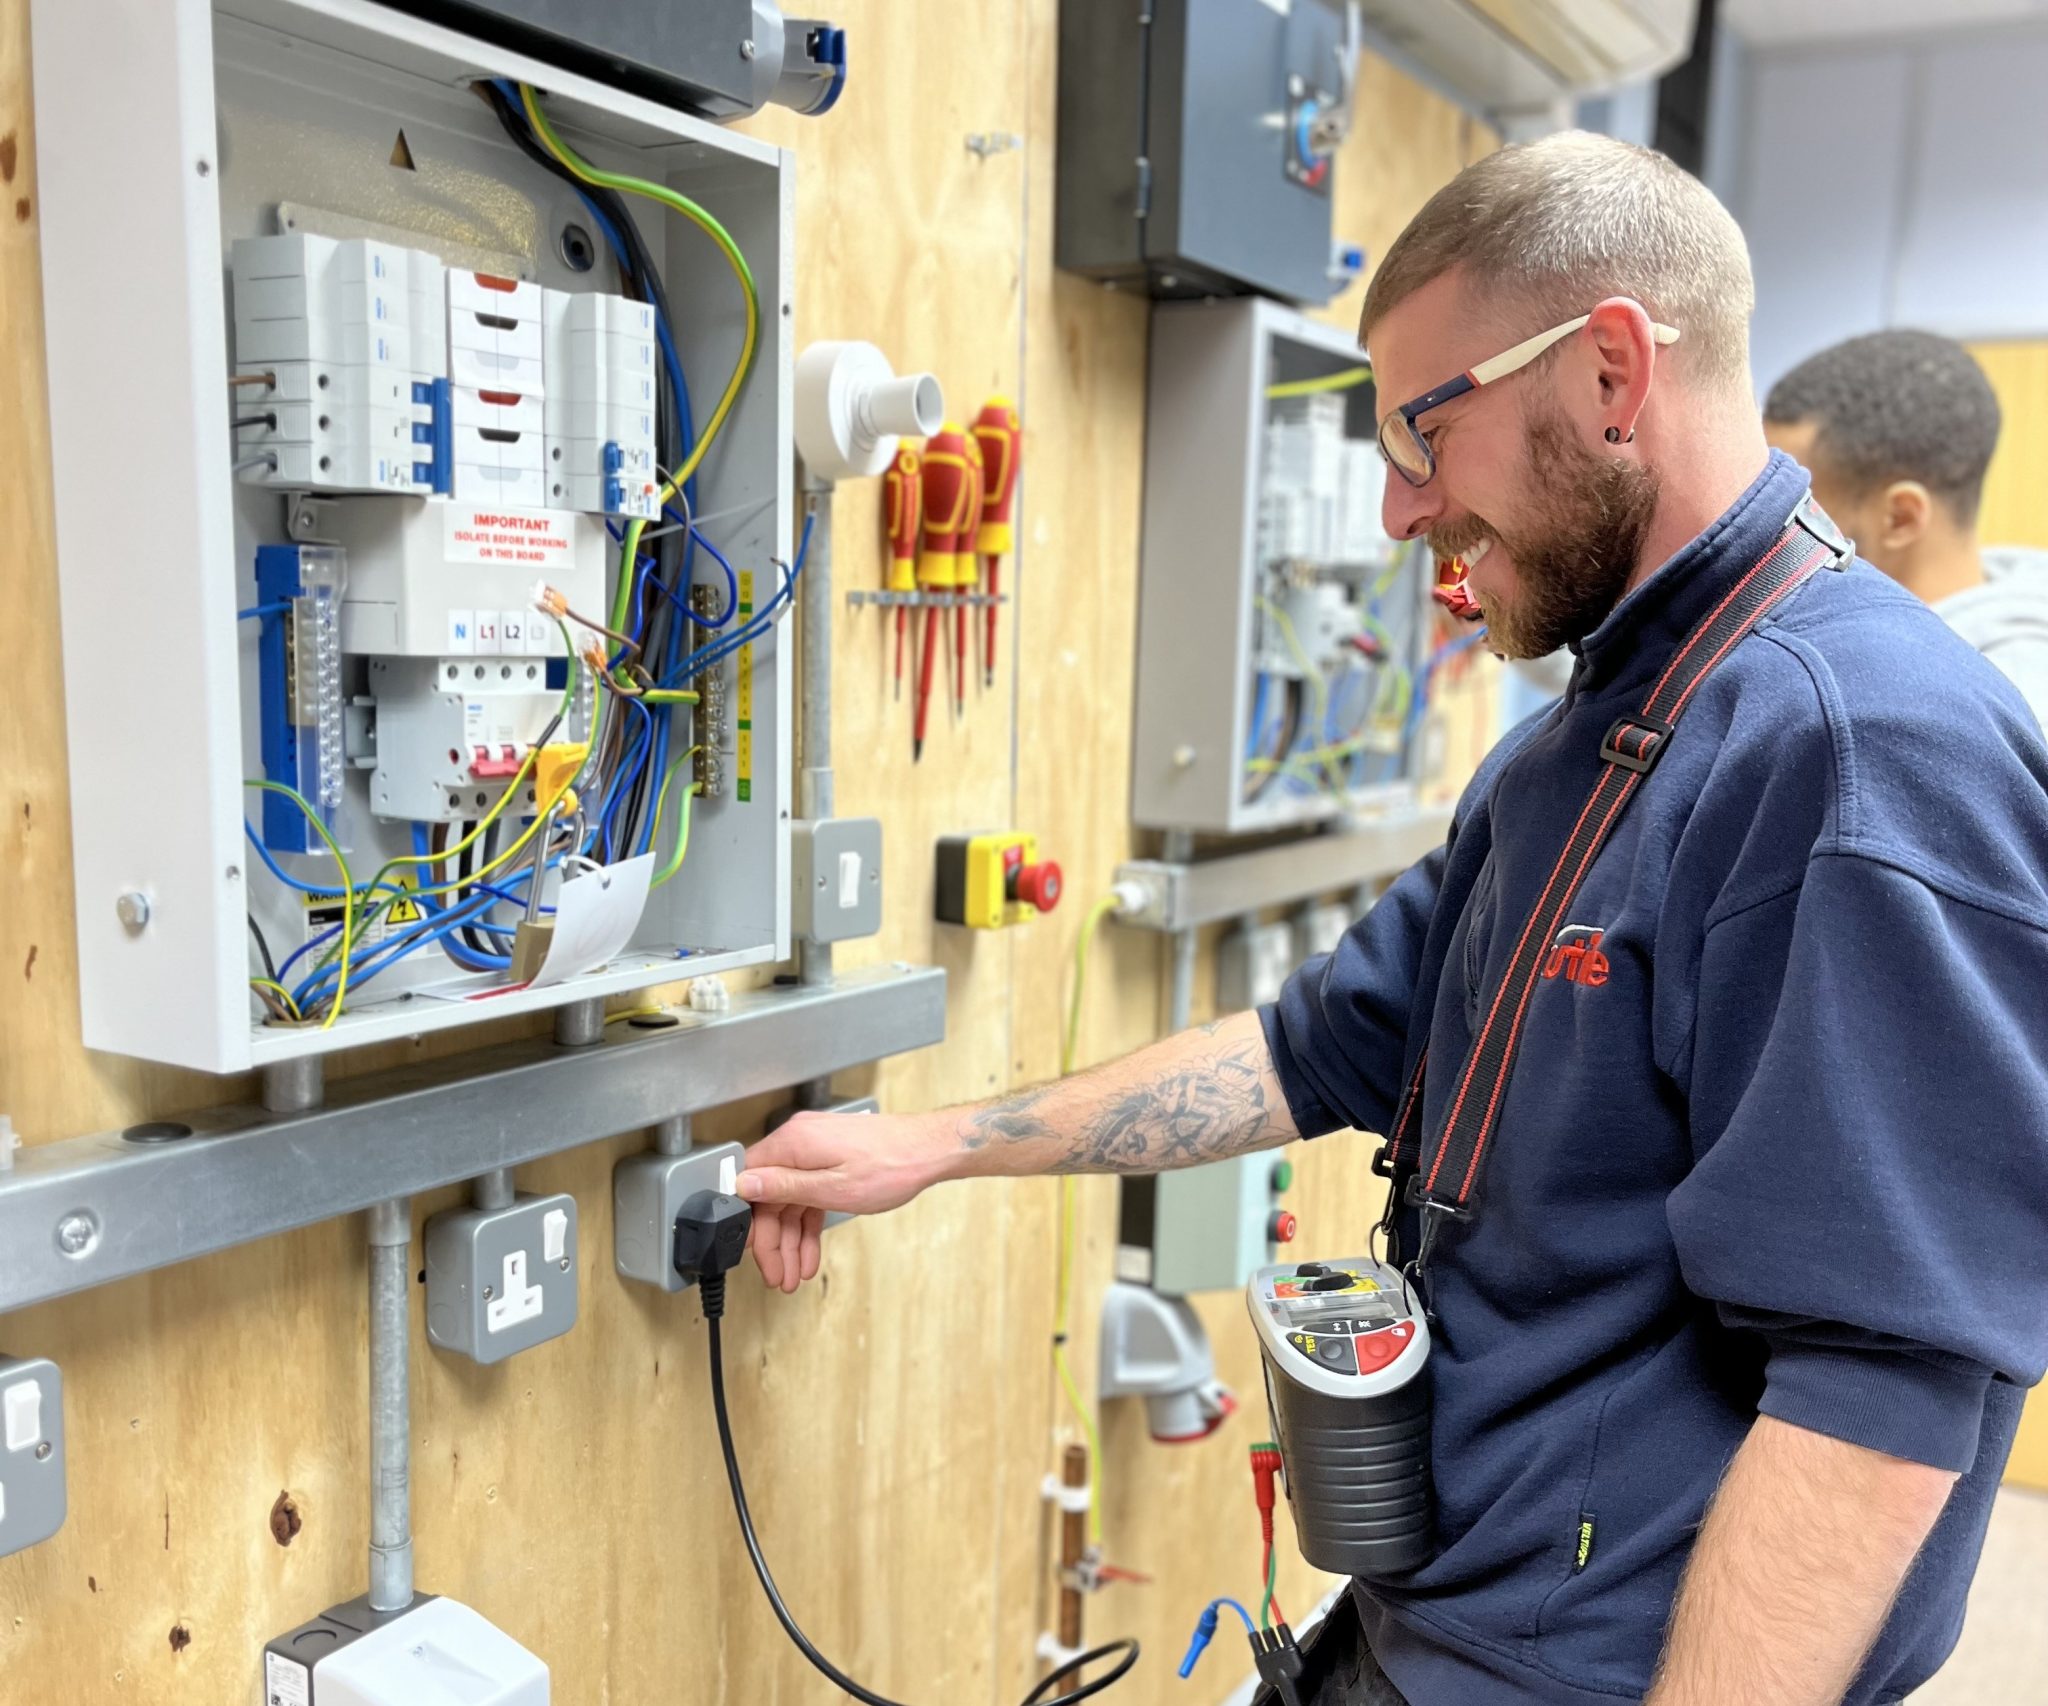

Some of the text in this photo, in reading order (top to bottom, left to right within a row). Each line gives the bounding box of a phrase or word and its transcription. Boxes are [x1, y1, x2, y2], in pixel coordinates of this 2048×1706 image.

[474, 514, 550, 531] IMPORTANT
[455, 531, 568, 549] ISOLATE BEFORE WORKING
[480, 548, 545, 561] ON THIS BOARD
[455, 624, 466, 639] N
[480, 624, 495, 639] L1
[505, 624, 520, 639] L2
[1305, 1335, 1316, 1354] TEST
